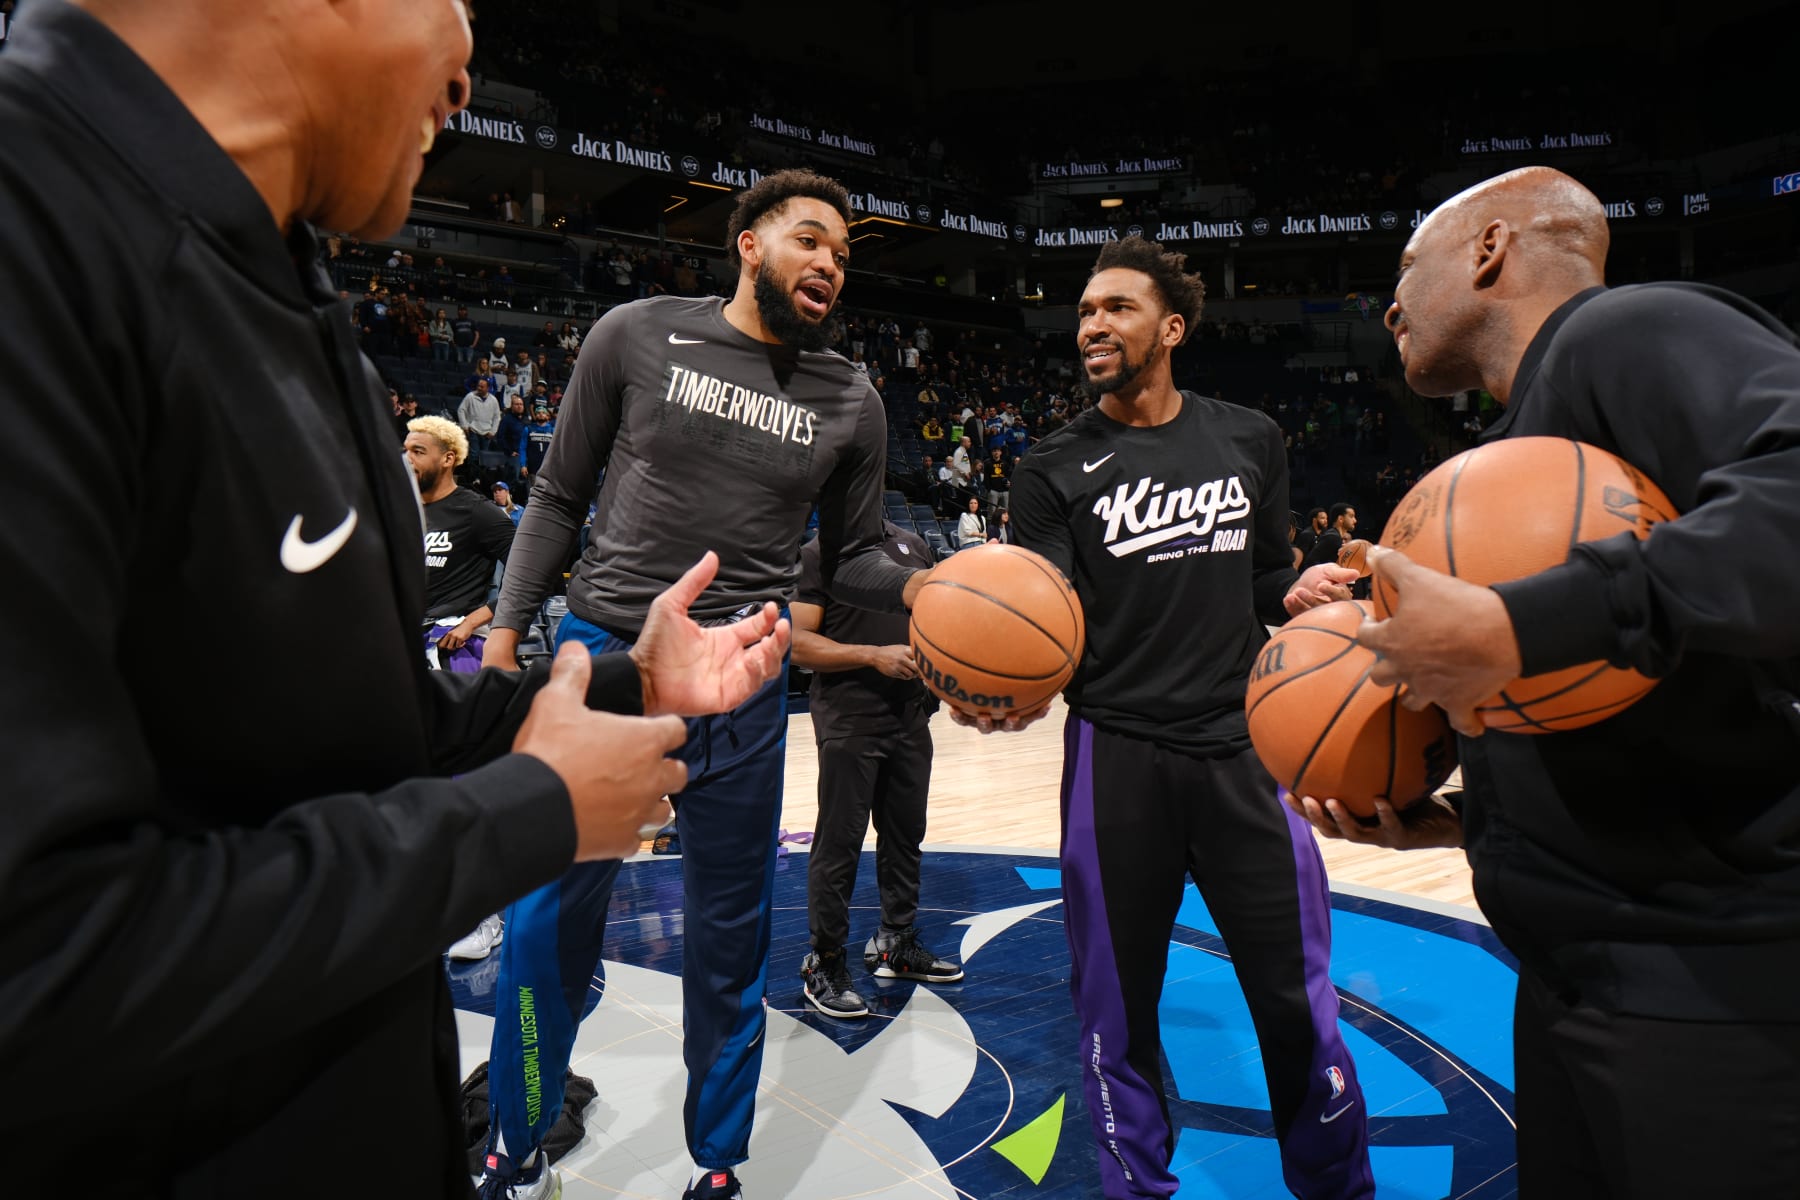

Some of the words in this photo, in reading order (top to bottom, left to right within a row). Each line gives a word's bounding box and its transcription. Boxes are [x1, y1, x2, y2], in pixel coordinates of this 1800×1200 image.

[818, 130, 841, 148] JACK
[1540, 134, 1568, 149] JACK
[571, 132, 612, 161] JACK
[616, 140, 672, 172] DANIEL'S
[712, 161, 747, 187] JACK
[1043, 164, 1067, 177] JACK
[1116, 159, 1141, 173] JACK
[847, 193, 864, 211] CK
[867, 193, 910, 220] DANIEL'S
[1603, 199, 1636, 218] NIEL'S
[1690, 203, 1710, 214] CHI
[940, 209, 968, 231] JACK
[1156, 222, 1190, 241] JACK
[1193, 220, 1243, 239] DANIEL'S
[1281, 216, 1316, 234] JACK
[1320, 213, 1371, 232] DANIEL'S
[413, 225, 436, 238] 112
[1035, 228, 1066, 246] JACK
[666, 365, 817, 446] TIMBERWOLVES
[1092, 476, 1250, 556] Kings
[1147, 550, 1184, 563] BRING
[1187, 545, 1208, 556] THE
[1211, 529, 1247, 553] ROAR
[914, 640, 1014, 709] Wilson
[518, 985, 539, 1046] MINNESOTA
[523, 1046, 542, 1127] TIMBERWOLVES
[1092, 1032, 1116, 1134] SACRAMENTO
